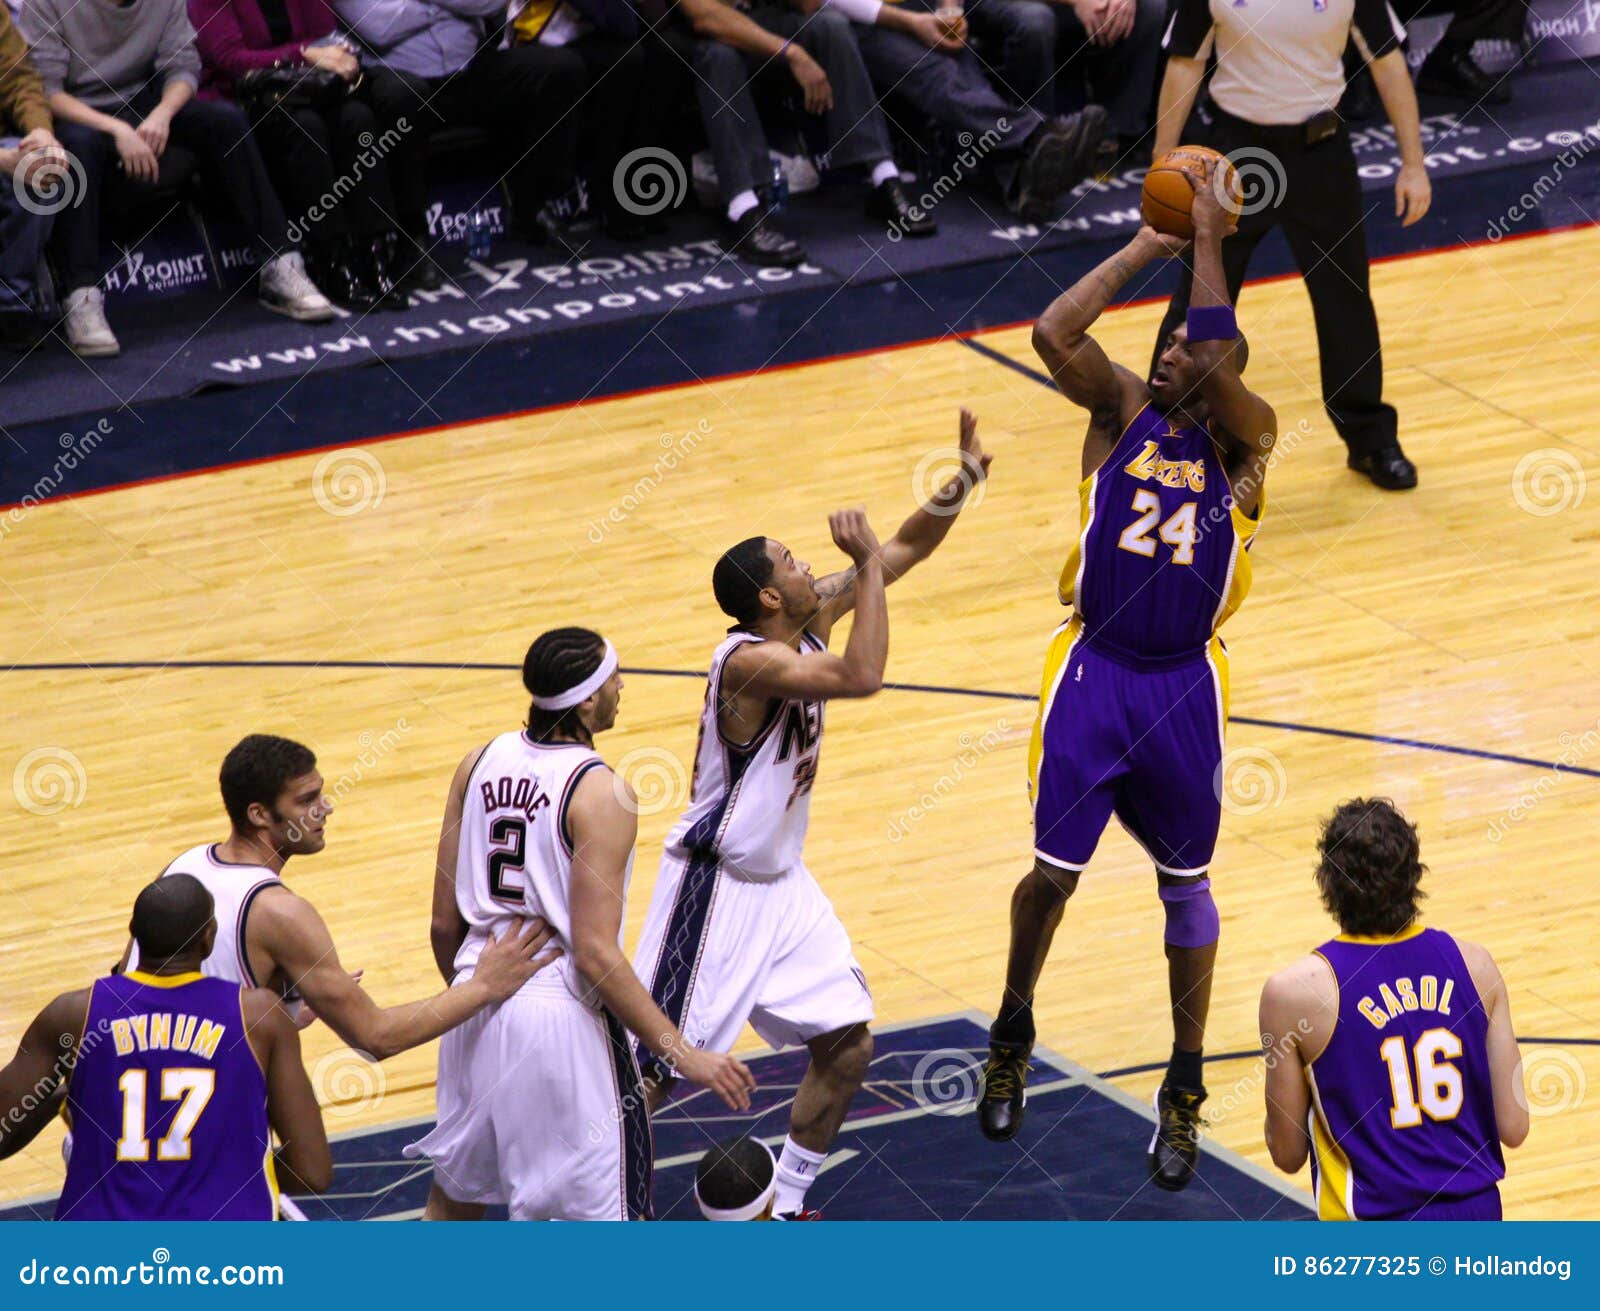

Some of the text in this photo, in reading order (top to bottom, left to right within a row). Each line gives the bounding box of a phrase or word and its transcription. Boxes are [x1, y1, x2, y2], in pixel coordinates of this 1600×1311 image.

[143, 253, 205, 283] POINT
[1117, 487, 1198, 566] 24
[486, 815, 527, 906] 2
[110, 1012, 226, 1061] BYNUM
[1357, 974, 1455, 1030] GASOL
[116, 1067, 217, 1162] 17
[1379, 1026, 1465, 1130] 16
